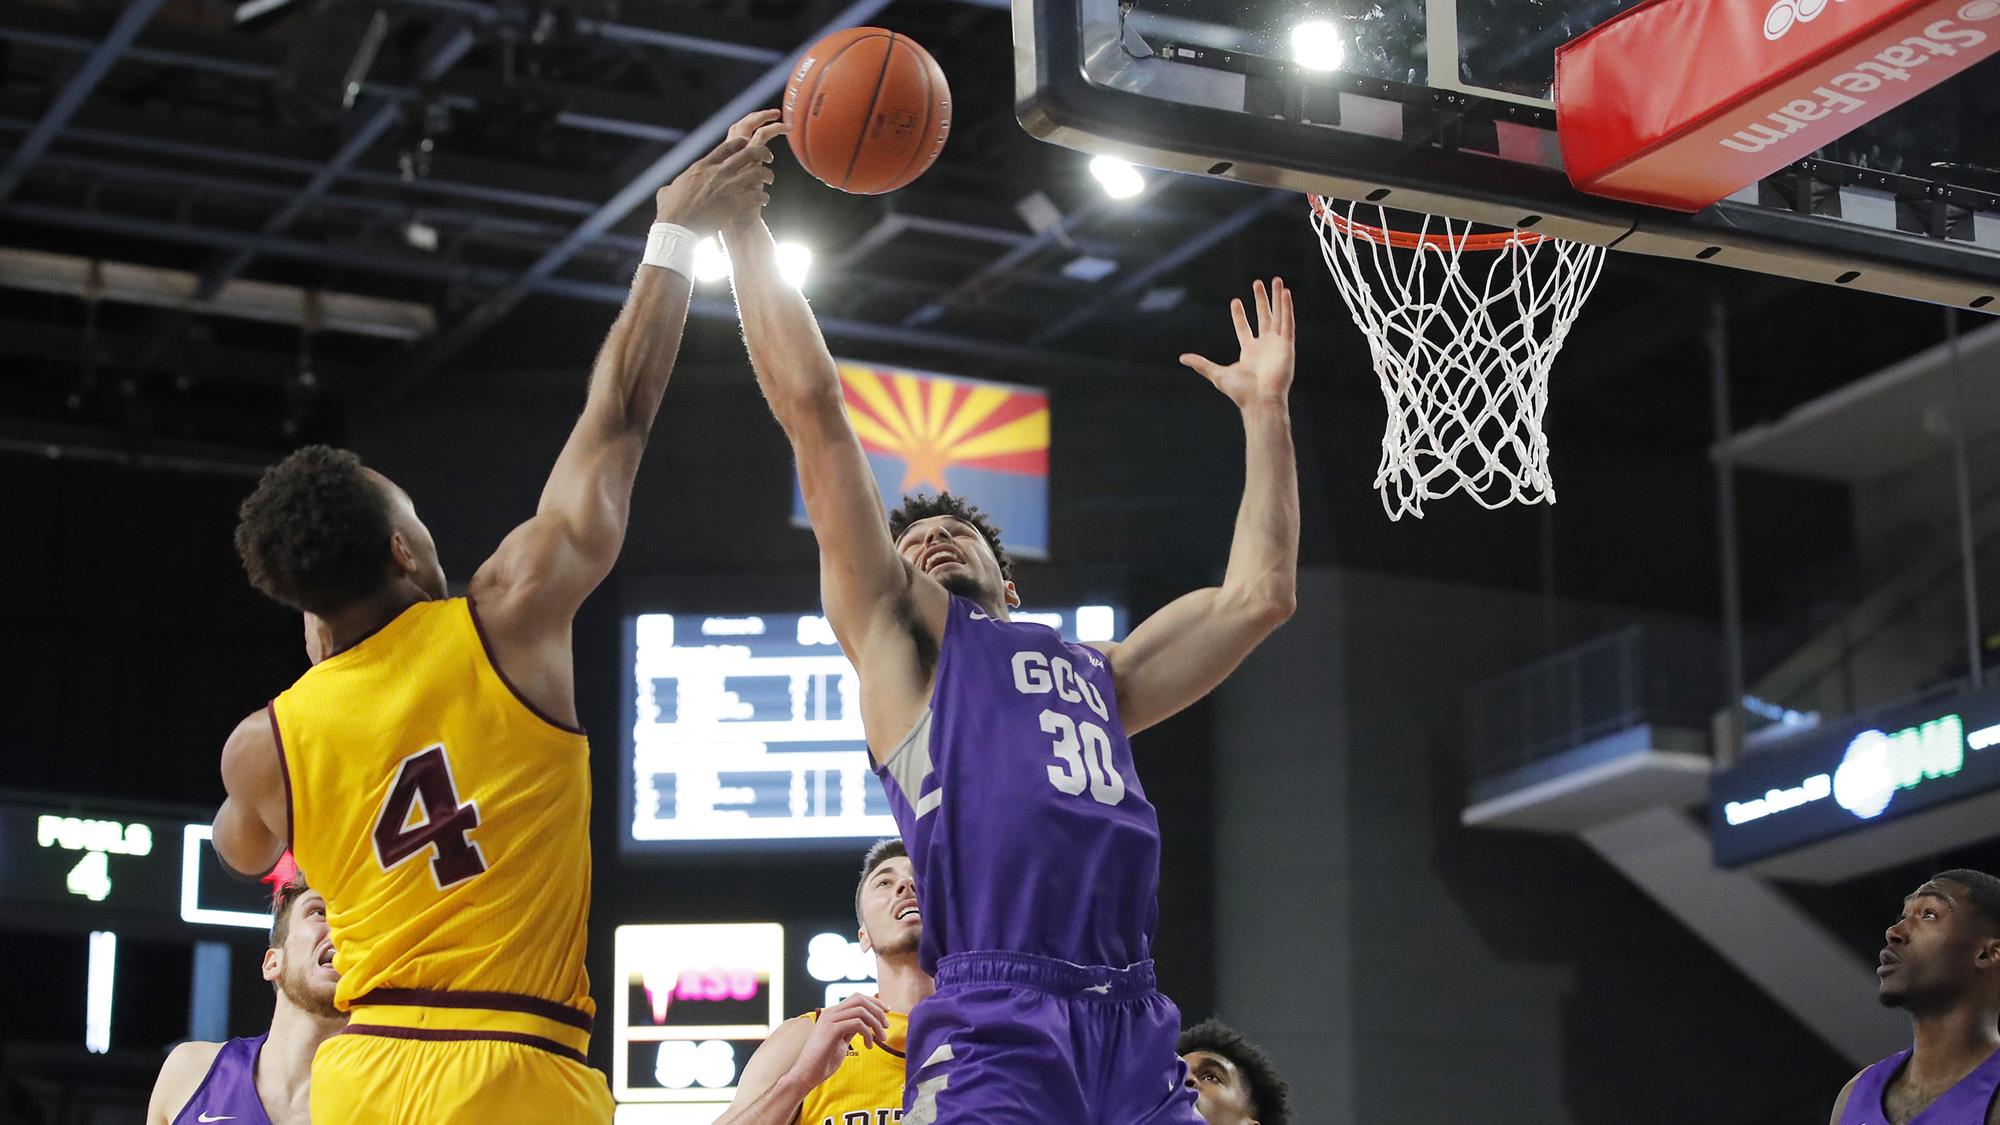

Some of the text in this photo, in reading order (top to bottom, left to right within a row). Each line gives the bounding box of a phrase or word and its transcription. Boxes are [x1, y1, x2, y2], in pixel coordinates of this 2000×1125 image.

[1011, 651, 1109, 721] GCU
[1039, 709, 1125, 806] 30
[371, 742, 488, 892] 4
[67, 851, 111, 901] 4
